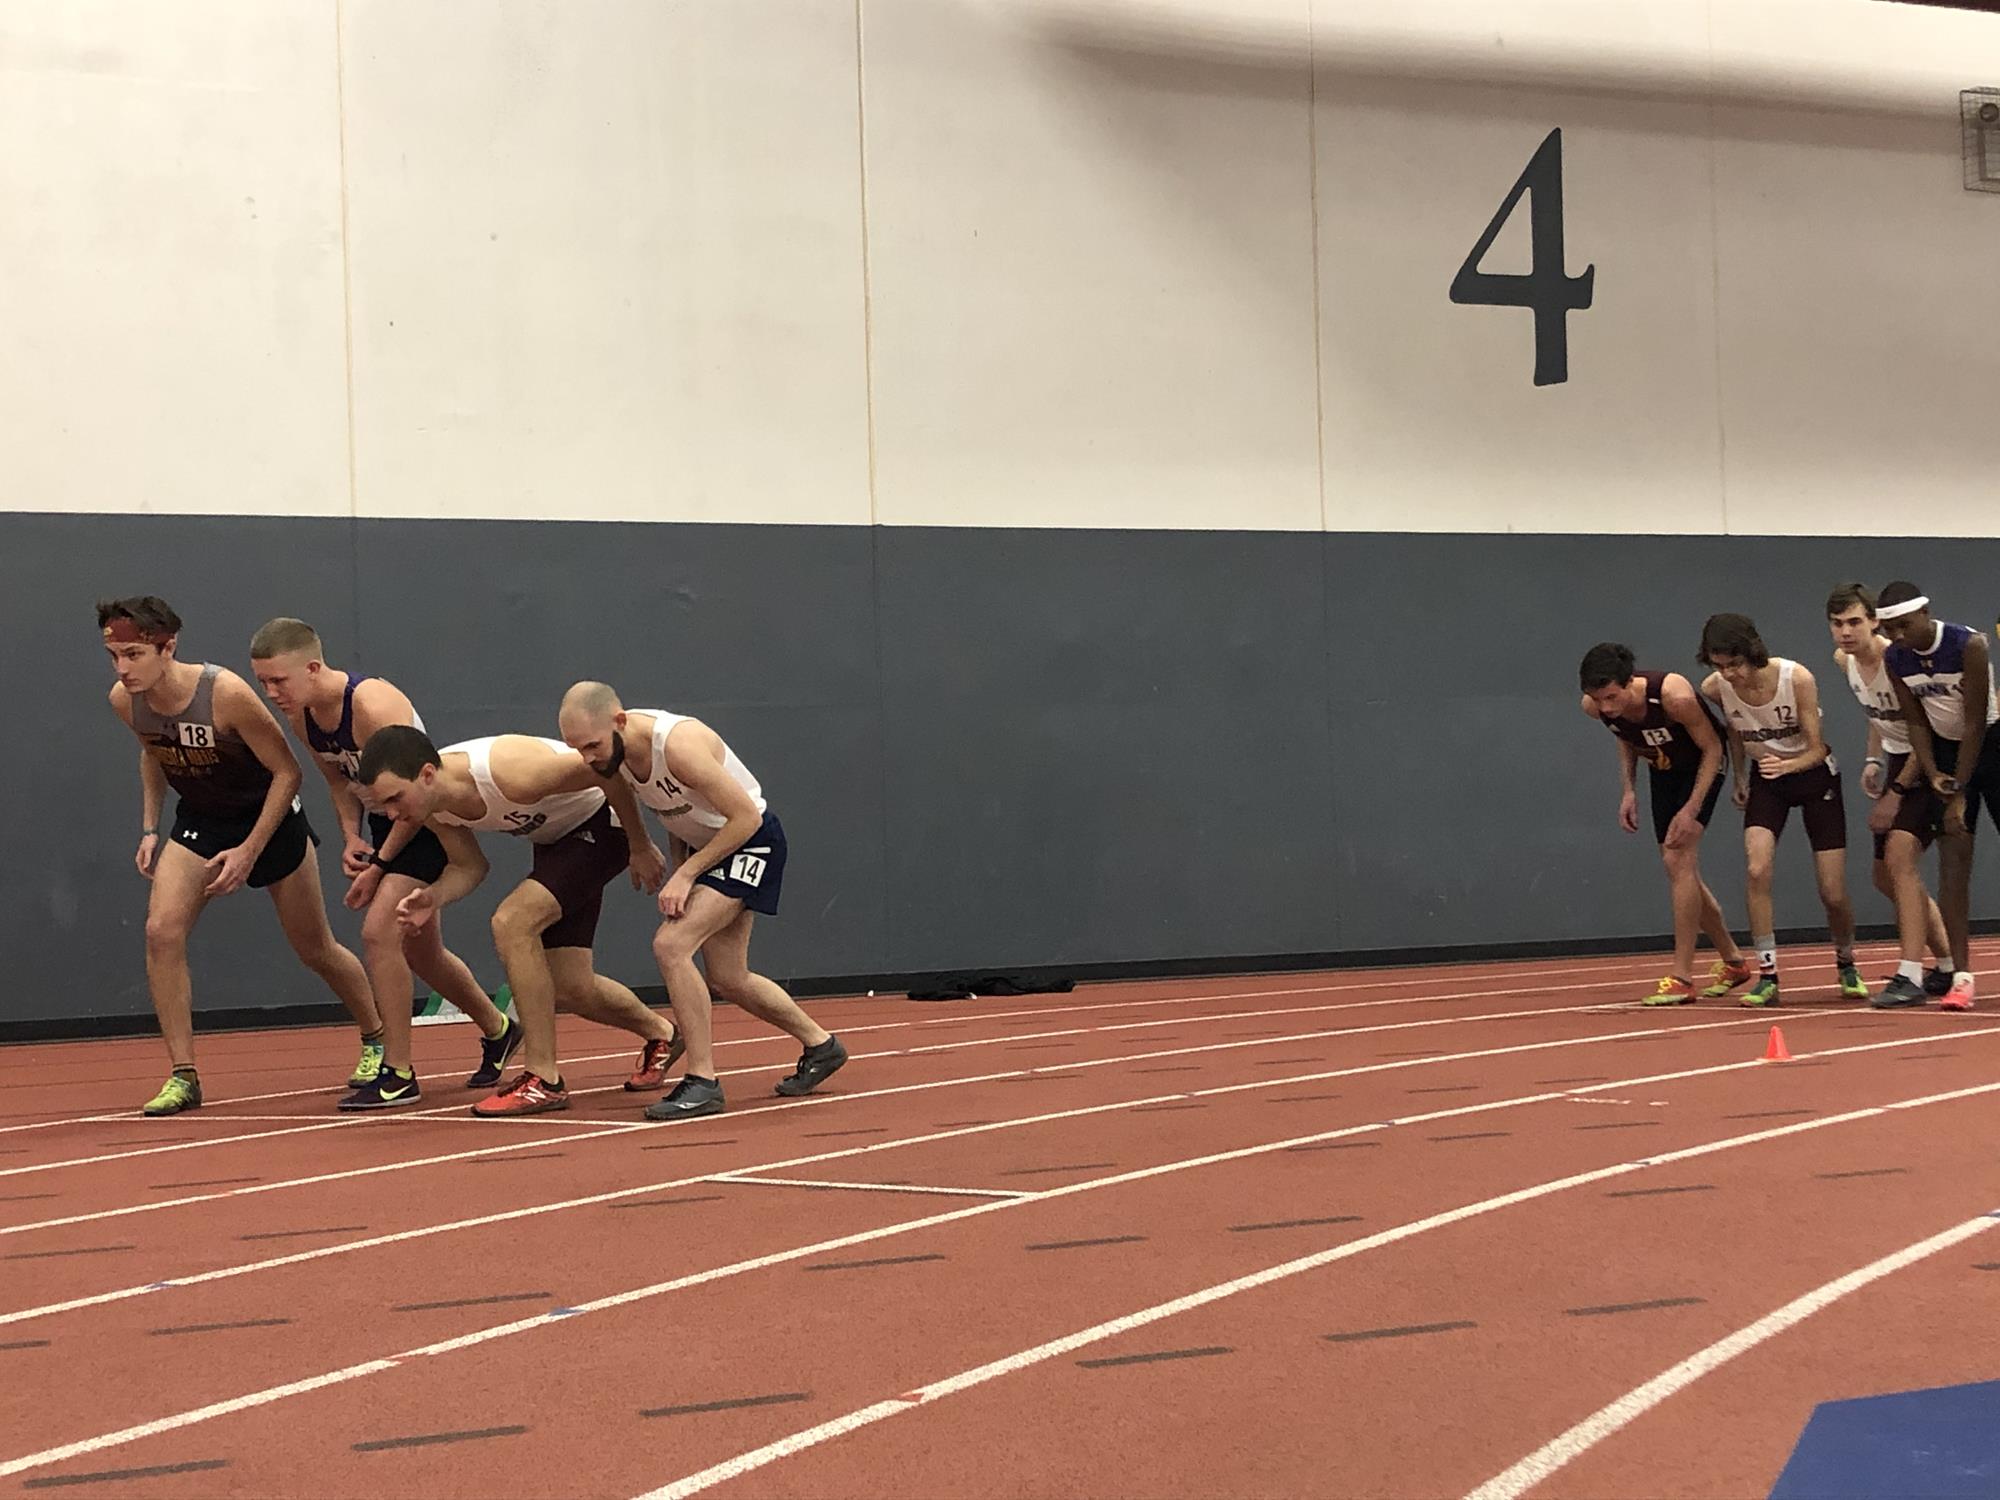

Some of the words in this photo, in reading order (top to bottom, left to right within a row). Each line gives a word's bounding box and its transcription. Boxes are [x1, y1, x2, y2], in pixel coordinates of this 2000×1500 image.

[1449, 127, 1595, 387] 4
[1774, 705, 1794, 722] 12
[184, 725, 209, 747] 18
[1647, 730, 1667, 745] 13
[655, 776, 682, 799] 14
[503, 810, 531, 826] 15
[739, 855, 760, 883] 14
